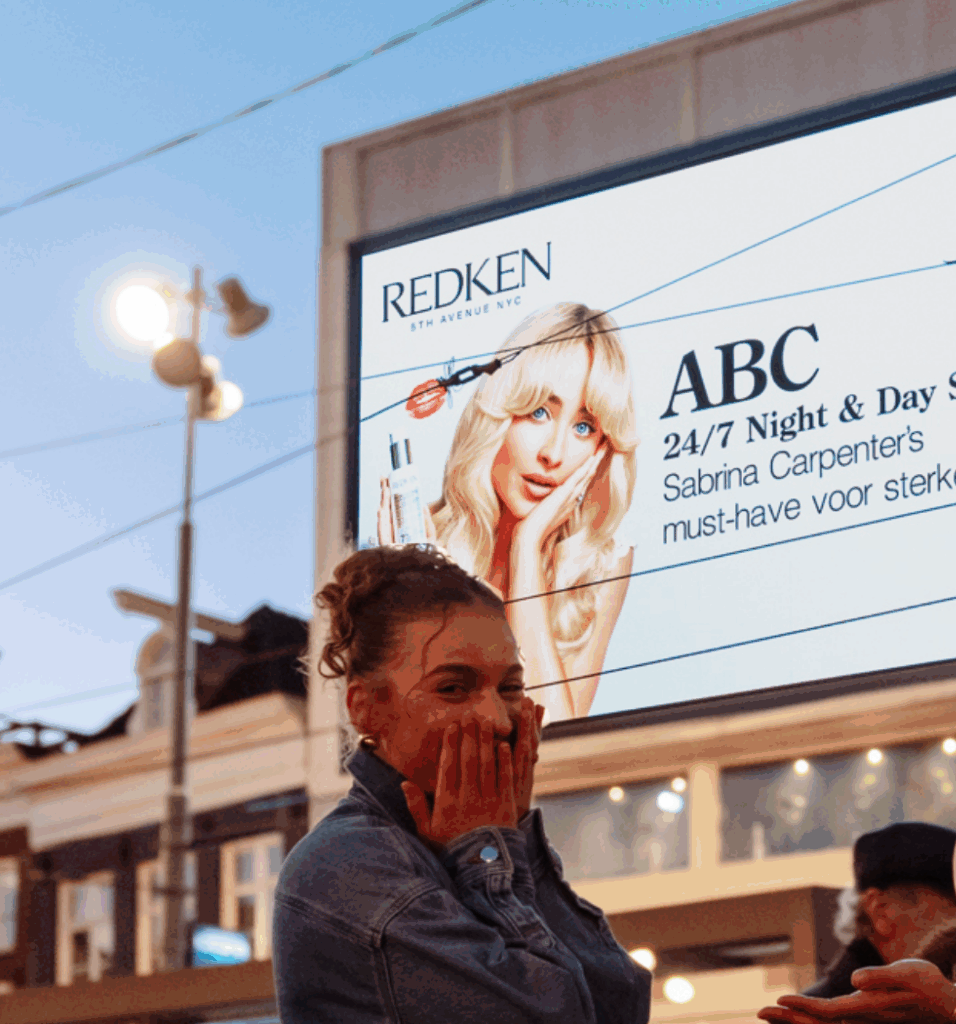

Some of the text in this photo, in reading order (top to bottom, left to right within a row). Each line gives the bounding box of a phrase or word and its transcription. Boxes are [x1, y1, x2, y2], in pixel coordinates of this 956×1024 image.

[382, 241, 552, 323] REDKEN
[410, 295, 522, 332] 5TH AVENUE NYC
[659, 323, 820, 420] ABC
[663, 420, 735, 461] 24/7
[746, 403, 829, 444] Night
[838, 394, 865, 423] &
[877, 385, 937, 416] Day
[663, 425, 924, 502] Sabrina Carpenter's
[663, 498, 801, 544] must-have
[812, 483, 873, 514] voor
